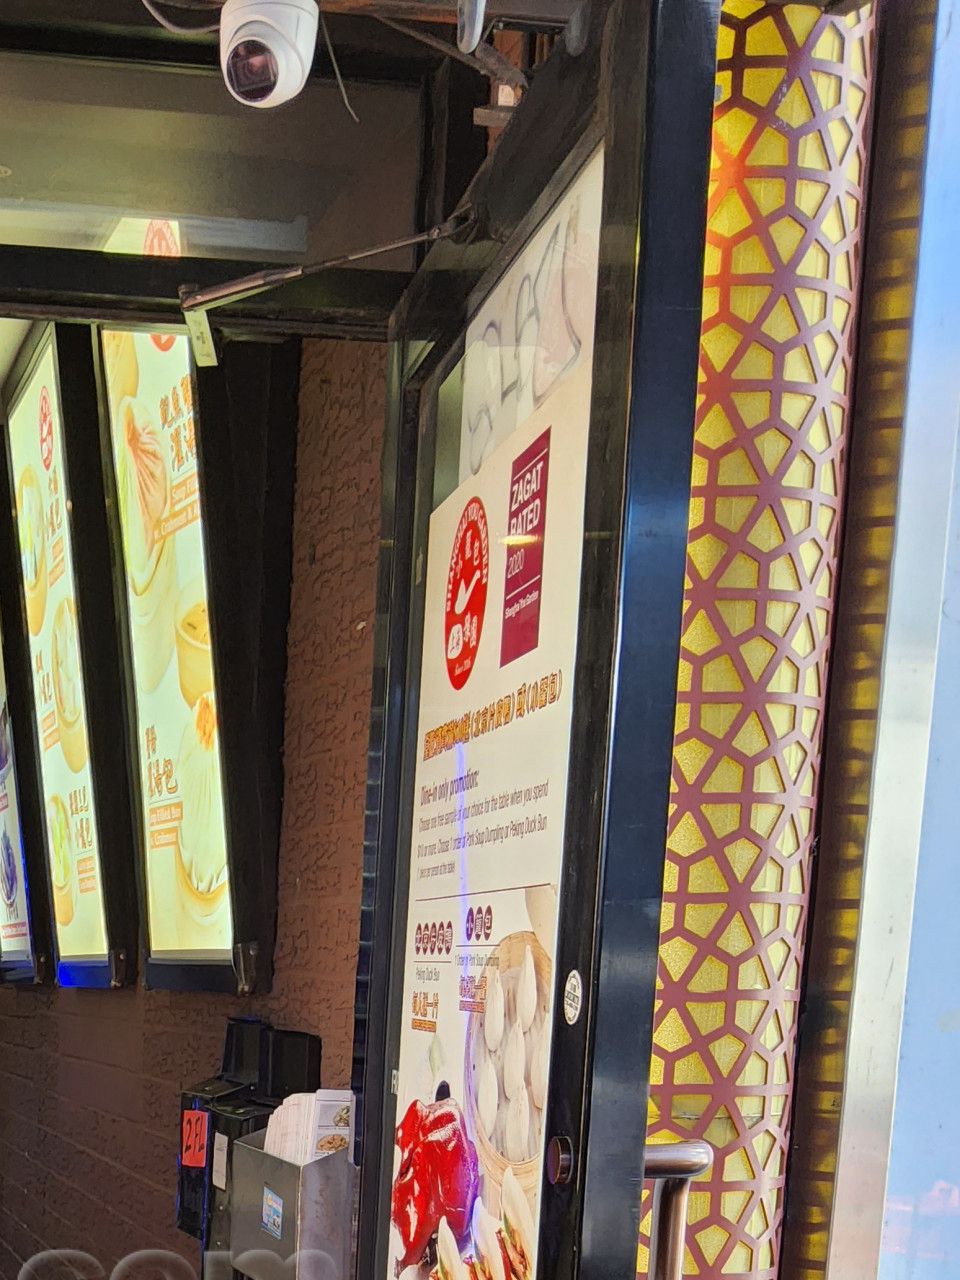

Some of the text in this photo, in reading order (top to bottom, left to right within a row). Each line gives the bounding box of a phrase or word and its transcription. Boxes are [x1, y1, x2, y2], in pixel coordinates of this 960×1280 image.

[510, 461, 544, 512] ZAGAT
[510, 498, 541, 542] RATED
[506, 555, 525, 581] 2020
